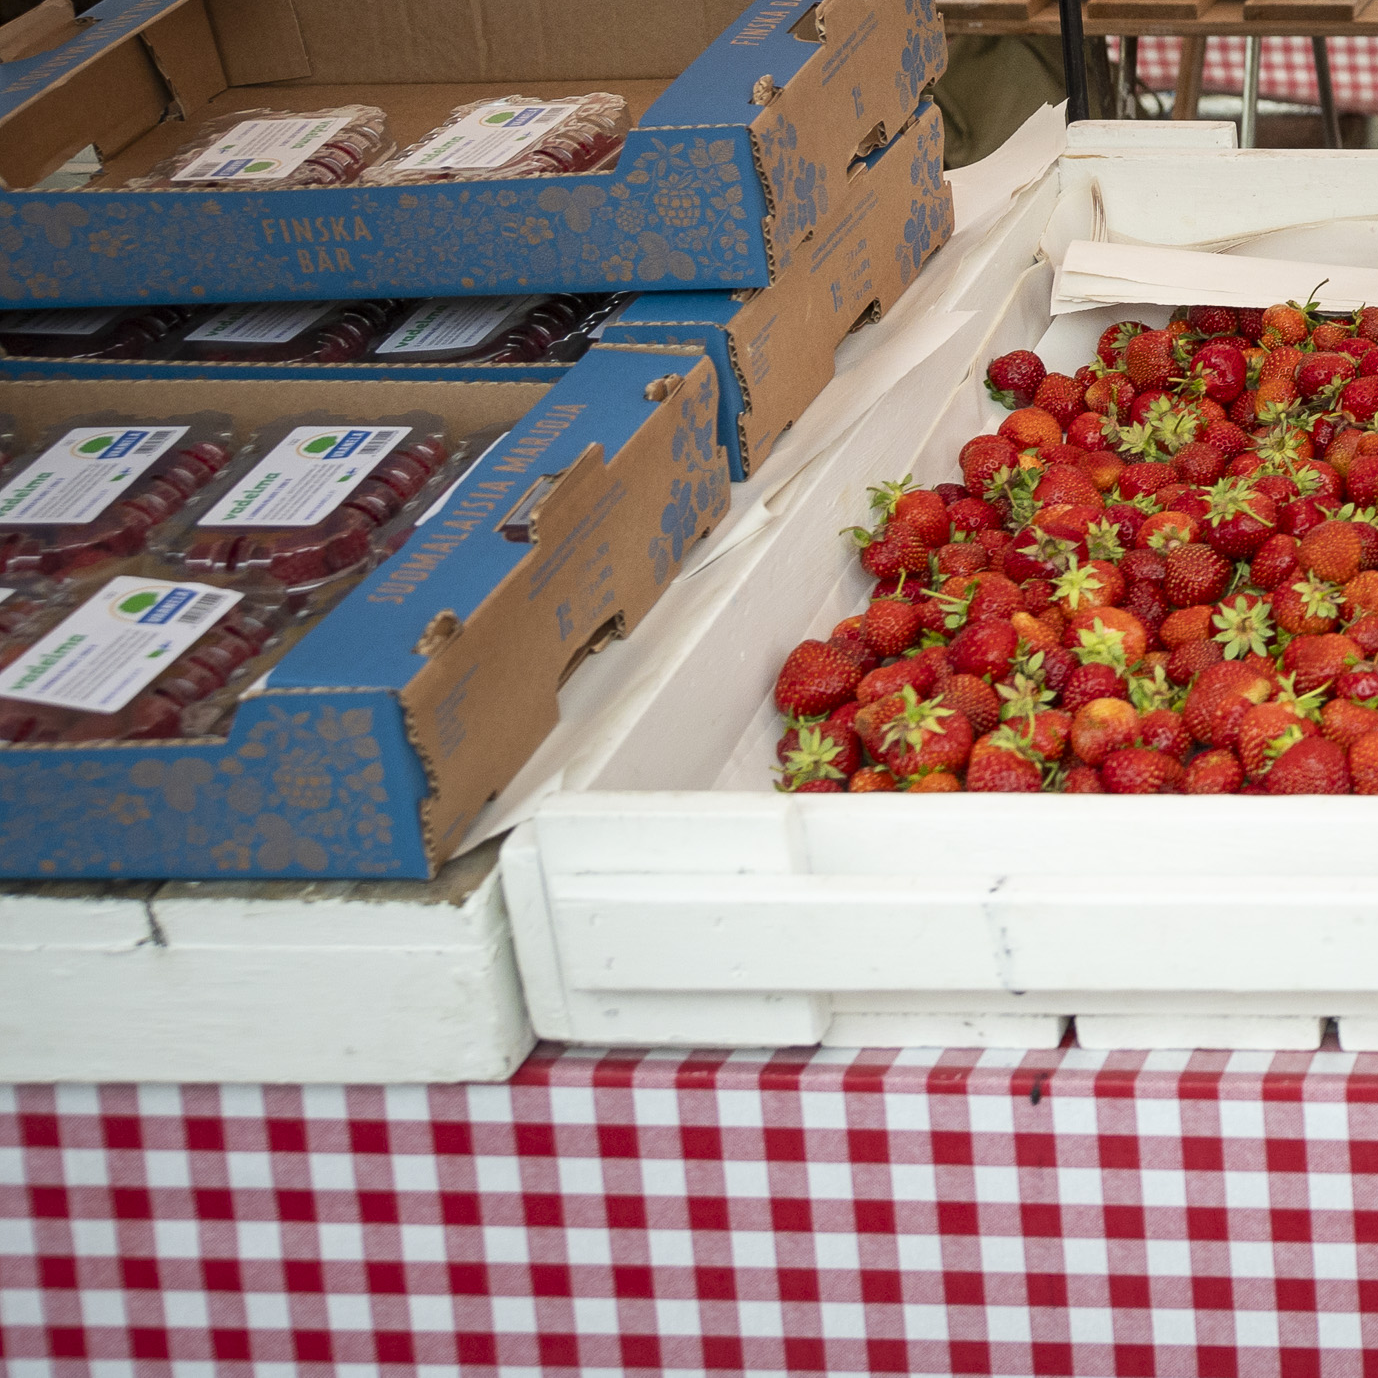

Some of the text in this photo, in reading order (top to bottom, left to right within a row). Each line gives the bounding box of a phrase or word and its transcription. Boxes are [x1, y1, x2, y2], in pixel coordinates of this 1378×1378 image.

[730, 10, 791, 46] FINSKA
[413, 136, 466, 167] vadelma
[261, 216, 373, 244] FINSKA
[296, 245, 356, 274] BÄR
[221, 472, 283, 521] vadelma
[367, 480, 516, 604] SUOMALAISIA
[493, 404, 588, 473] MARJOJA
[8, 633, 89, 691] vadelma
